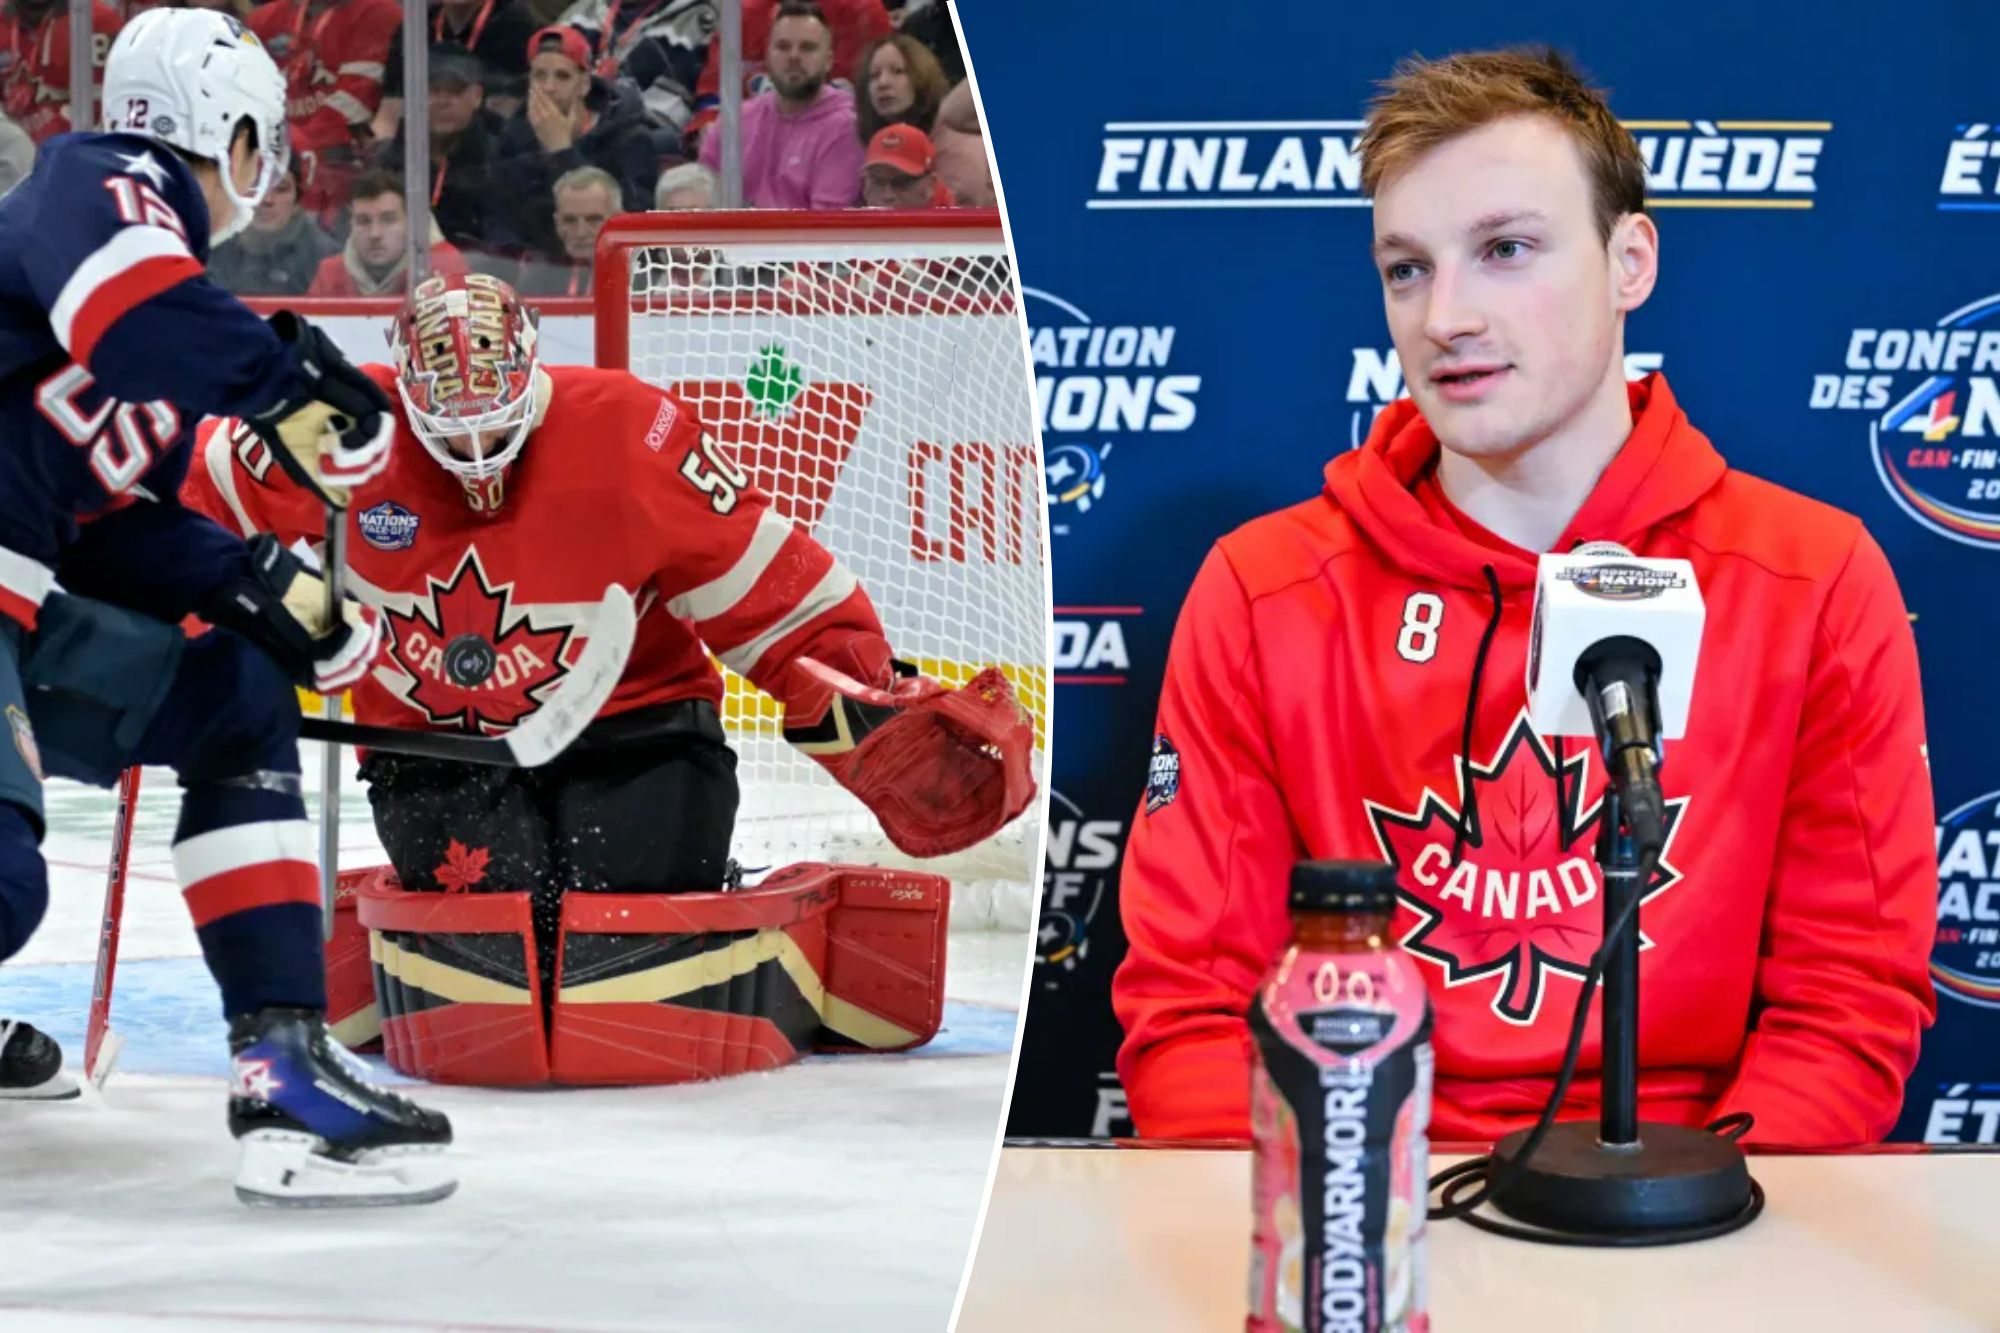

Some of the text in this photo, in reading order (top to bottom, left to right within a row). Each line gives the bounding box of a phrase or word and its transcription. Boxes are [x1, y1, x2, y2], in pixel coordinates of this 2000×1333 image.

[127, 99, 149, 128] 12
[1097, 137, 1362, 191] FINLAN
[1639, 120, 1824, 192] UÈDE
[1026, 326, 1176, 367] ATION
[1846, 329, 2000, 371] CONFR
[1036, 375, 1202, 432] IONS
[1809, 375, 1893, 409] DES
[34, 364, 181, 494] US
[678, 429, 748, 516] 50
[1967, 478, 2000, 499] 20
[359, 511, 419, 528] NATIONS
[907, 440, 1042, 566] CAN
[1600, 576, 1687, 588] NATIONS
[1054, 621, 1130, 669] DA
[1397, 591, 1444, 663] 8
[405, 632, 545, 690] CADA
[1412, 843, 1601, 919] CANAD
[1975, 951, 2000, 968] 20
[1924, 1083, 2000, 1144] ÉT
